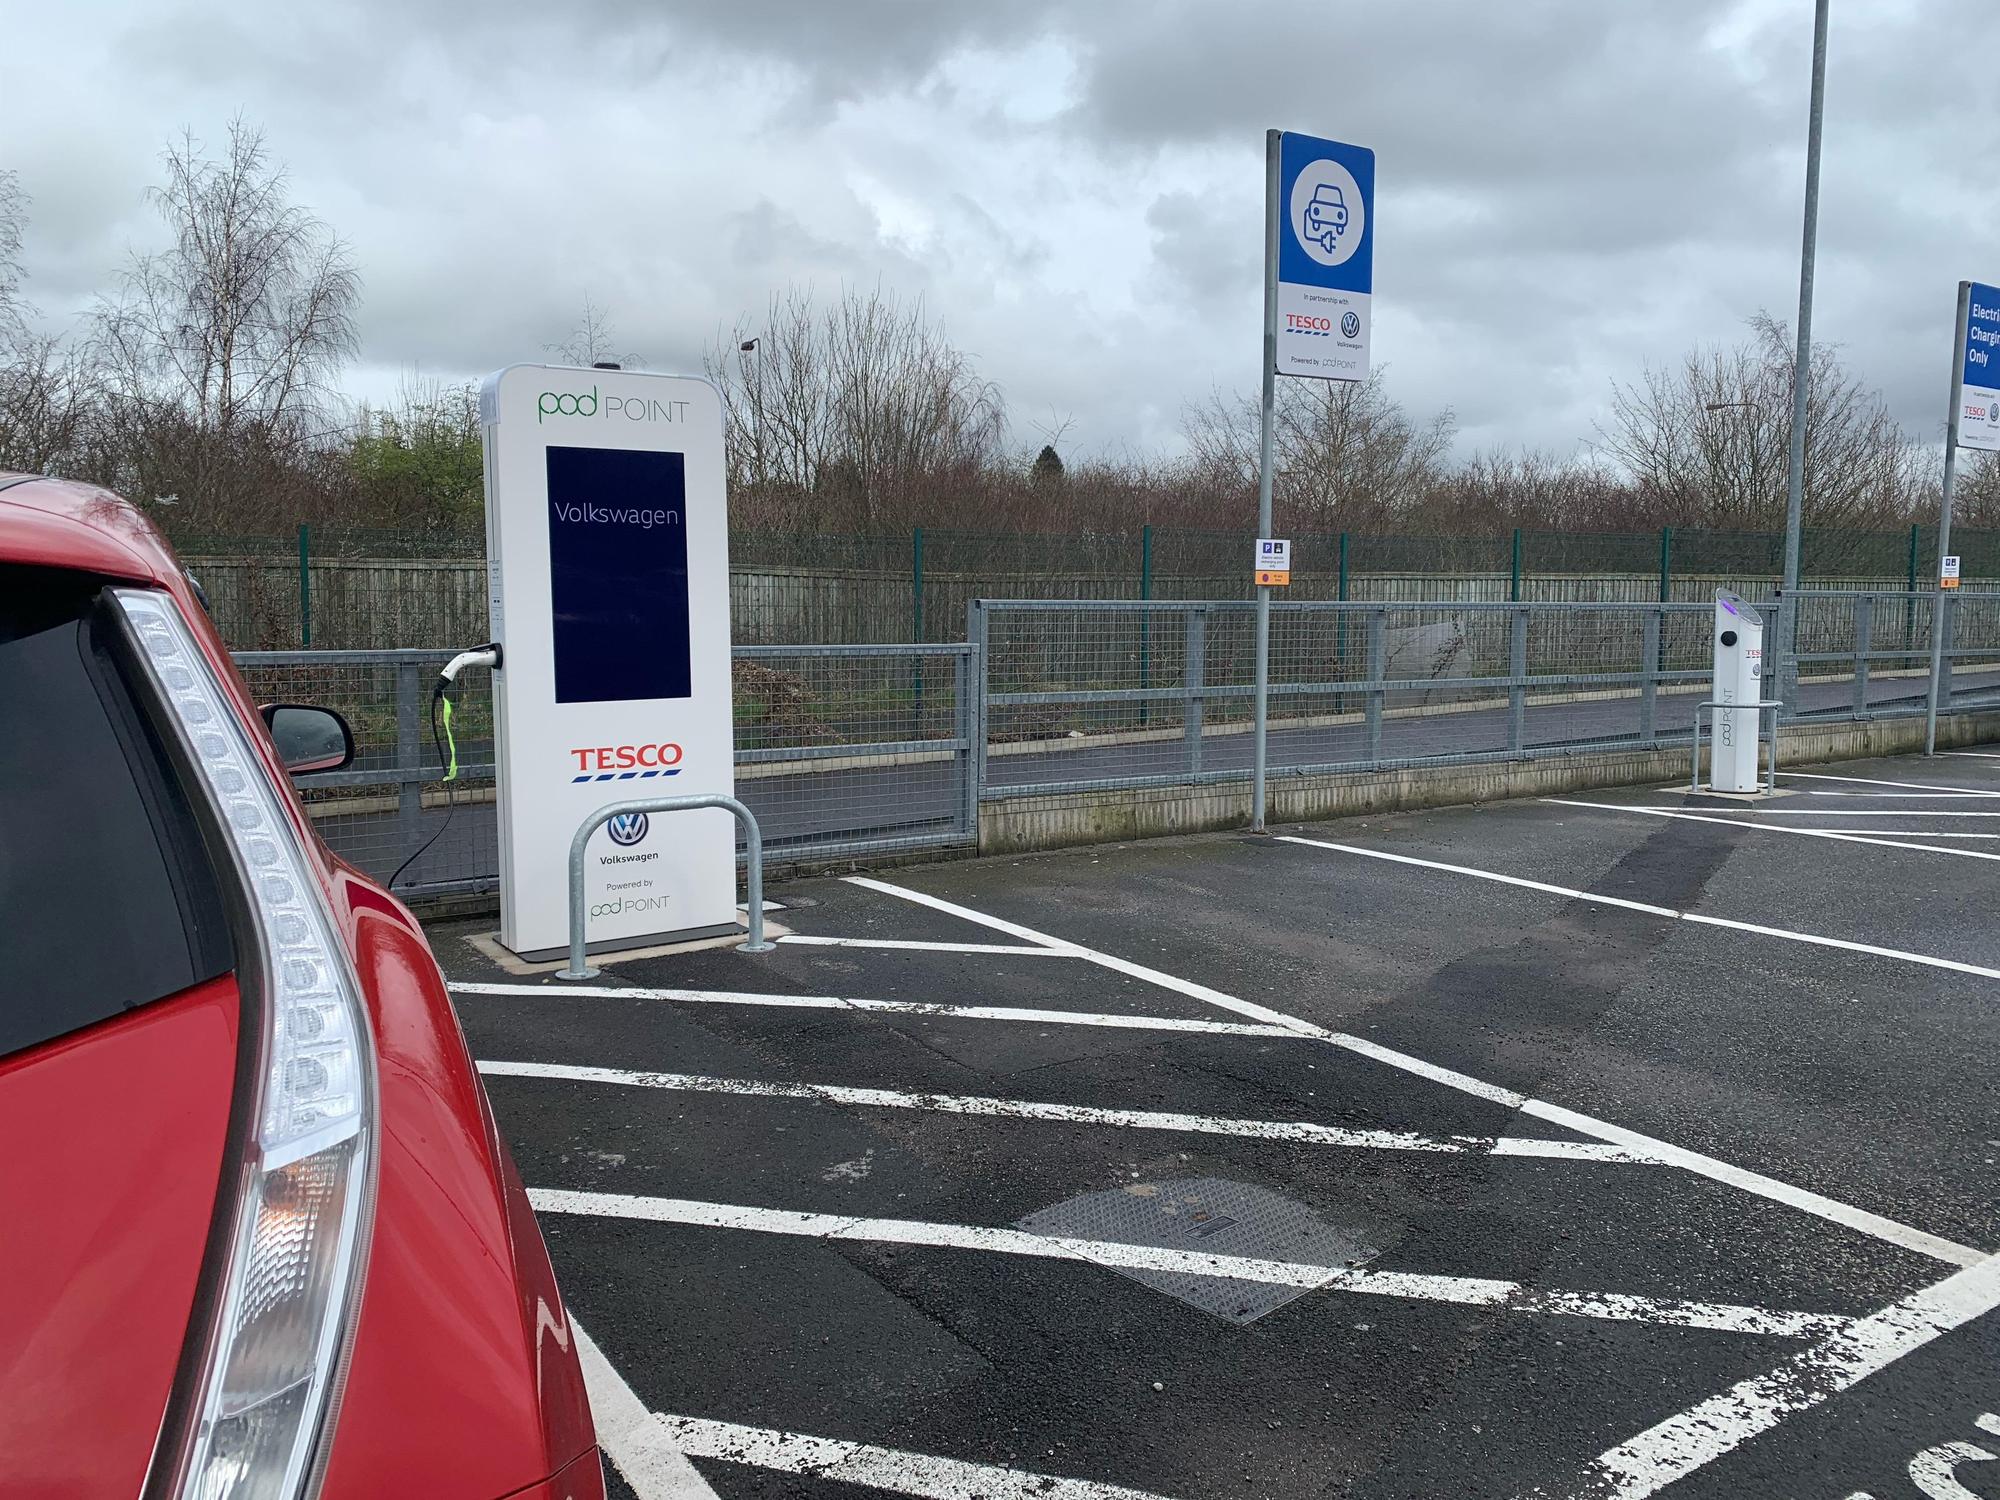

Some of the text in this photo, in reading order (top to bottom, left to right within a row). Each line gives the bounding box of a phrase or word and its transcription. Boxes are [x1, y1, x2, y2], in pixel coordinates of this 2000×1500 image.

[1309, 295, 1338, 305] partnership
[1973, 303, 2000, 322] Electri
[1286, 314, 1331, 331] TESCO
[1971, 326, 2000, 347] Chargin
[1291, 356, 1313, 365] Powered
[1969, 348, 1989, 368] Only
[538, 385, 690, 424] pod POINT
[1965, 405, 1986, 417] TESCO
[555, 502, 679, 529] Volkswagen
[1723, 688, 1732, 722] PONT
[571, 743, 683, 771] TESCO
[600, 852, 659, 865] Volkswagen
[606, 879, 654, 891] Powered by
[590, 895, 671, 922] pod POINT
